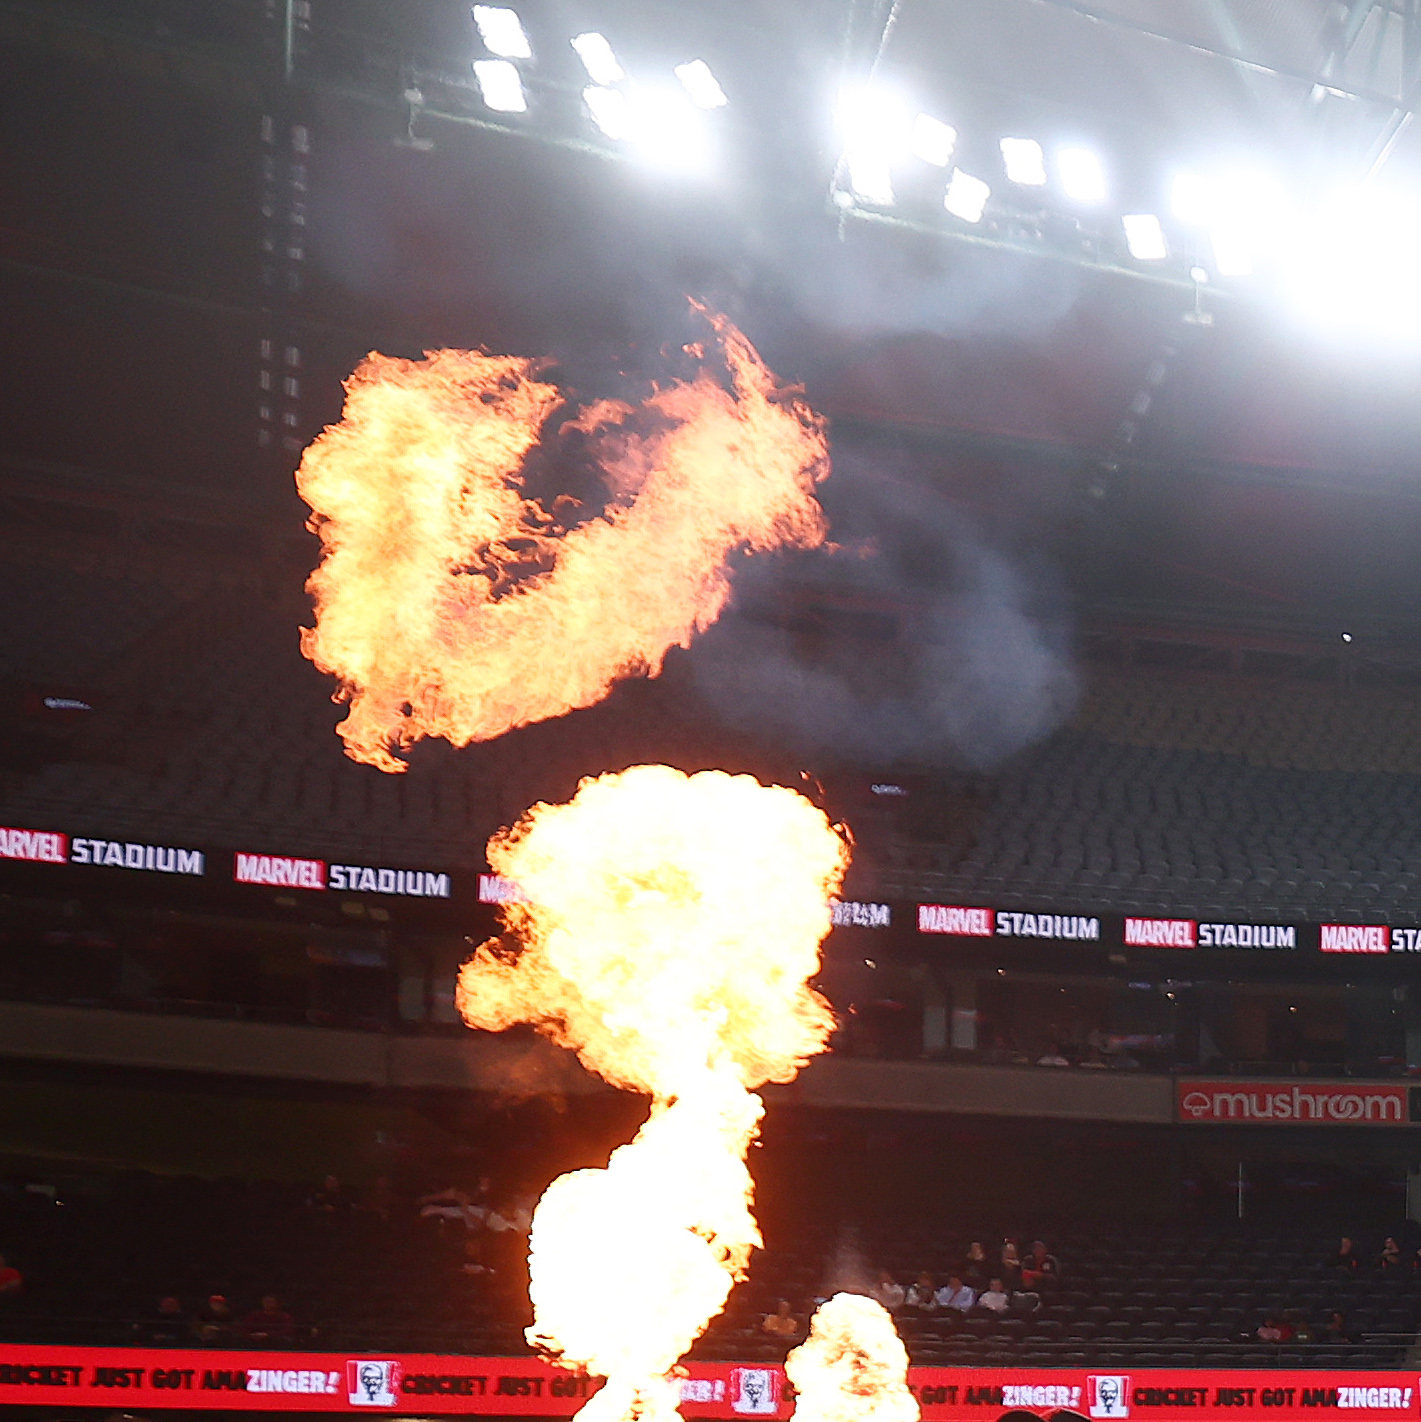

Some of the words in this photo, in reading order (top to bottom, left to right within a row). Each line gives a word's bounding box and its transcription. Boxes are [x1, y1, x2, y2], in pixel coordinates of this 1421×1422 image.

[0, 828, 64, 863] ARVEL
[71, 838, 203, 876] STADIUM
[235, 852, 325, 889] MARVEL
[329, 865, 449, 898] STADIUM
[918, 905, 992, 936] MARVEL
[996, 911, 1100, 940] STADIUM
[1124, 918, 1195, 947] MARVEL
[1198, 924, 1296, 950] STADIUM
[1320, 924, 1388, 952] MARVEL
[1212, 1085, 1402, 1120] mushroom
[0, 1364, 83, 1387] RICKET
[91, 1367, 145, 1388] JUST
[151, 1369, 195, 1390] GOT
[202, 1368, 340, 1394] AMAZINGER!
[493, 1374, 541, 1398] JUST
[920, 1384, 962, 1406] GOT
[1134, 1386, 1208, 1407] CRICKET
[1213, 1387, 1254, 1407] JUST
[1261, 1387, 1296, 1407] GOT
[1300, 1386, 1413, 1409] AMAZINGER!
